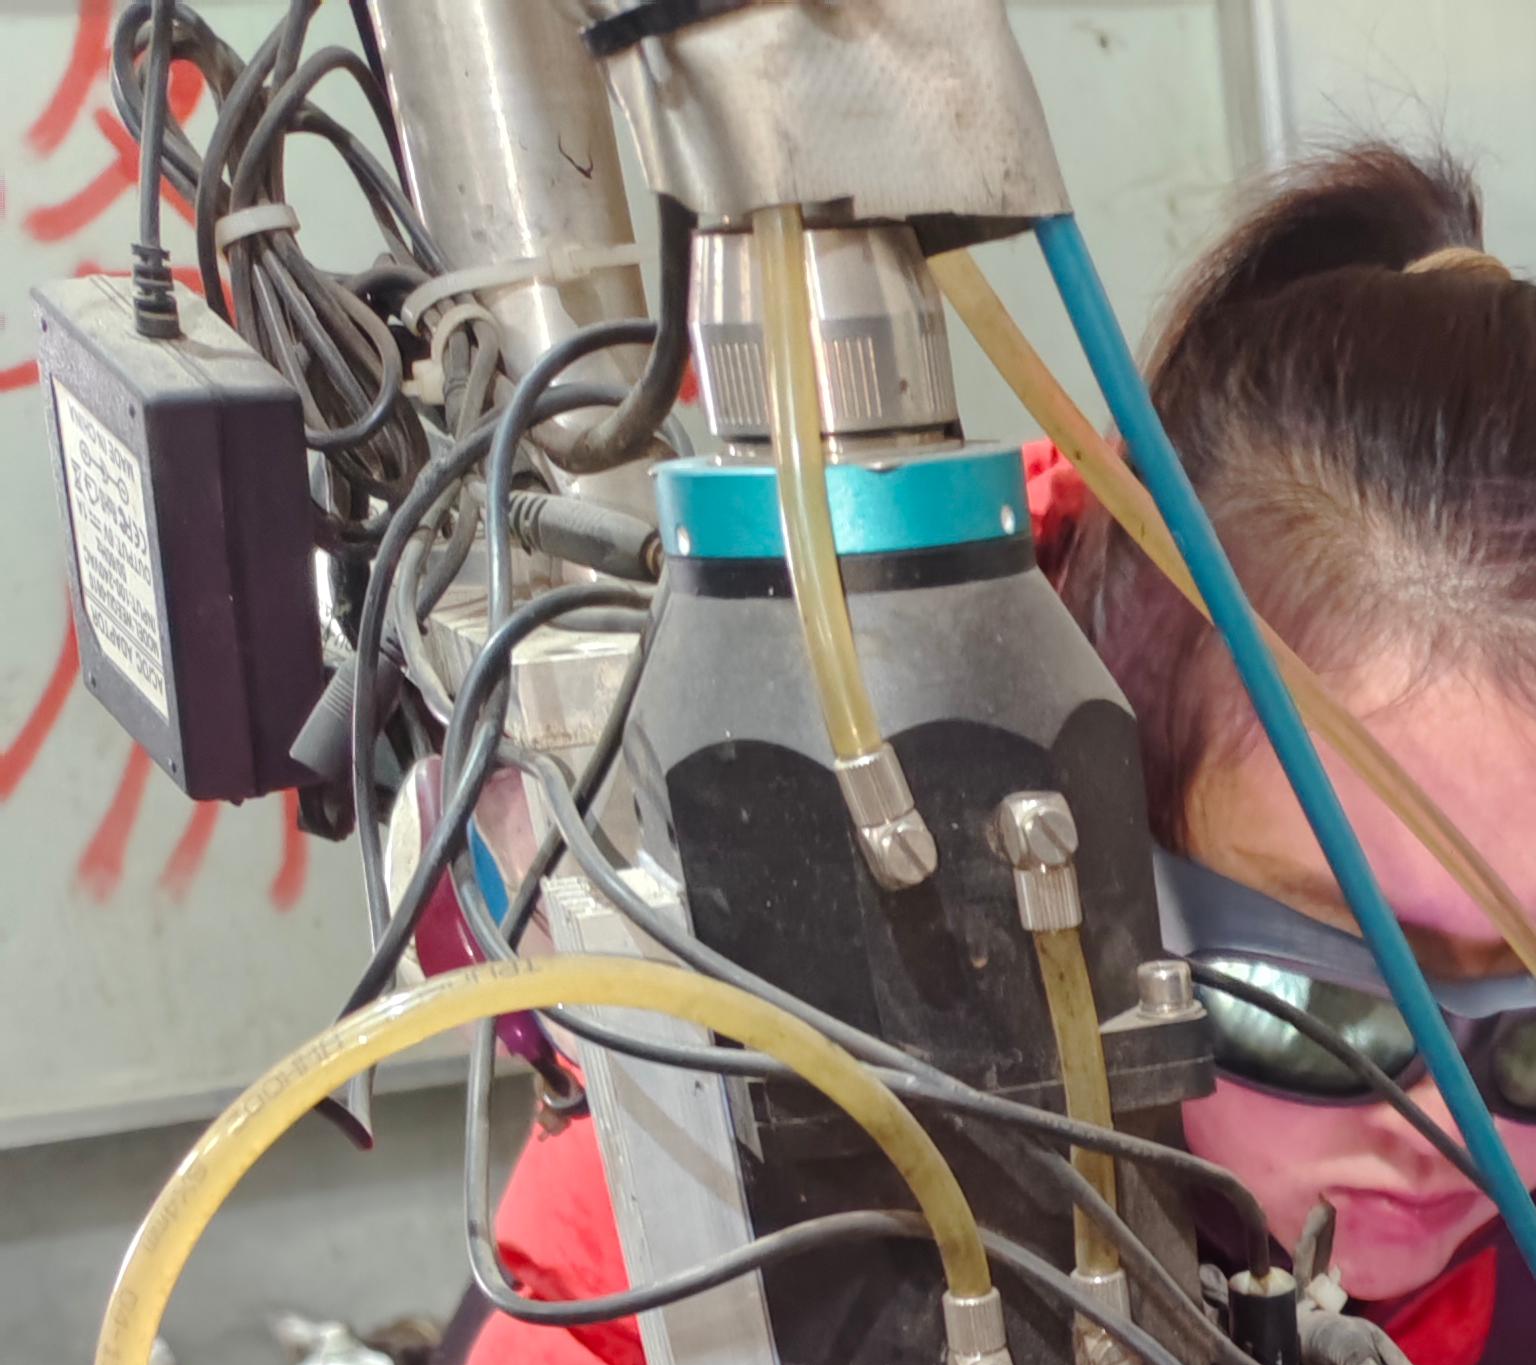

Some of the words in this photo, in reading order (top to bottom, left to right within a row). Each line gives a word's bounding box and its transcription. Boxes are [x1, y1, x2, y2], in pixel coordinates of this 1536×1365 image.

[66, 397, 96, 446] CHINA
[107, 438, 135, 485] MADE
[90, 603, 134, 667] ADAPTOR
[135, 650, 163, 697] AC/DC
